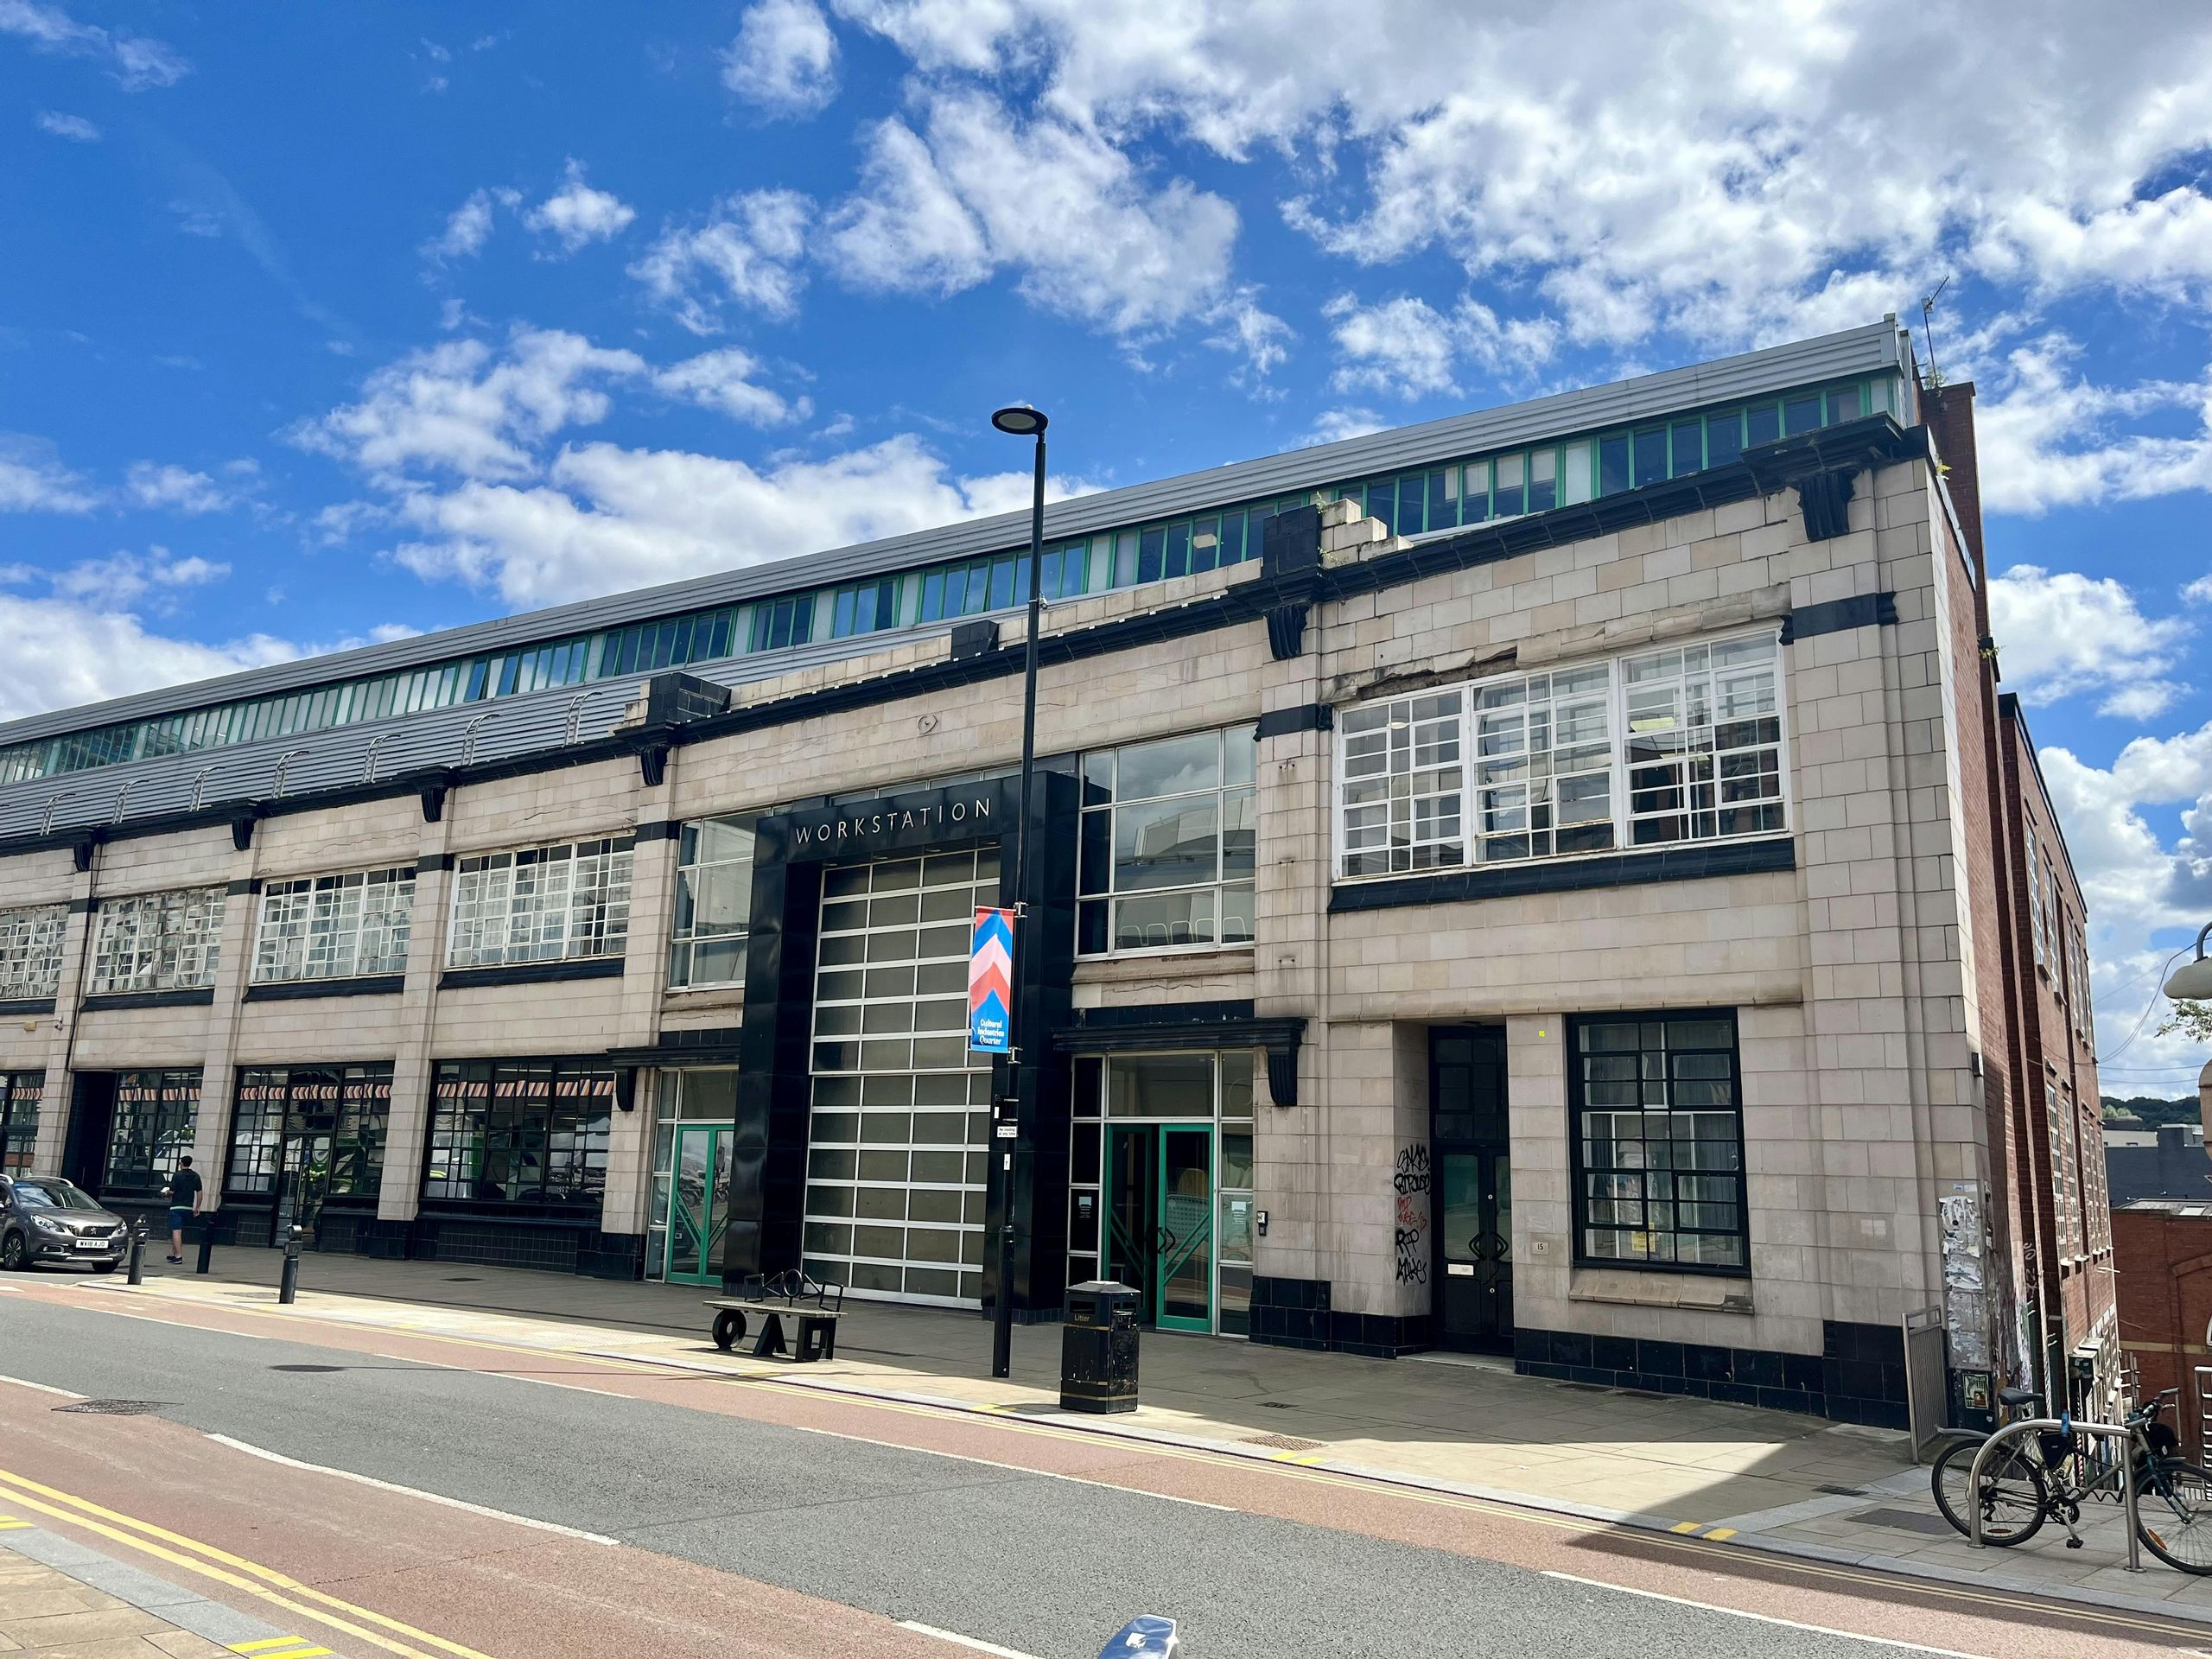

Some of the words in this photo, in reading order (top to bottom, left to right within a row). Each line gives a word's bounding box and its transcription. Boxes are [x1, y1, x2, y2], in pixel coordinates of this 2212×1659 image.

[796, 798, 990, 844] WORKSTATION
[980, 1018, 1002, 1028] Cultural
[977, 1027, 1005, 1037] Industries
[979, 1035, 1002, 1046] Quarter
[1074, 1313, 1090, 1322] Litter
